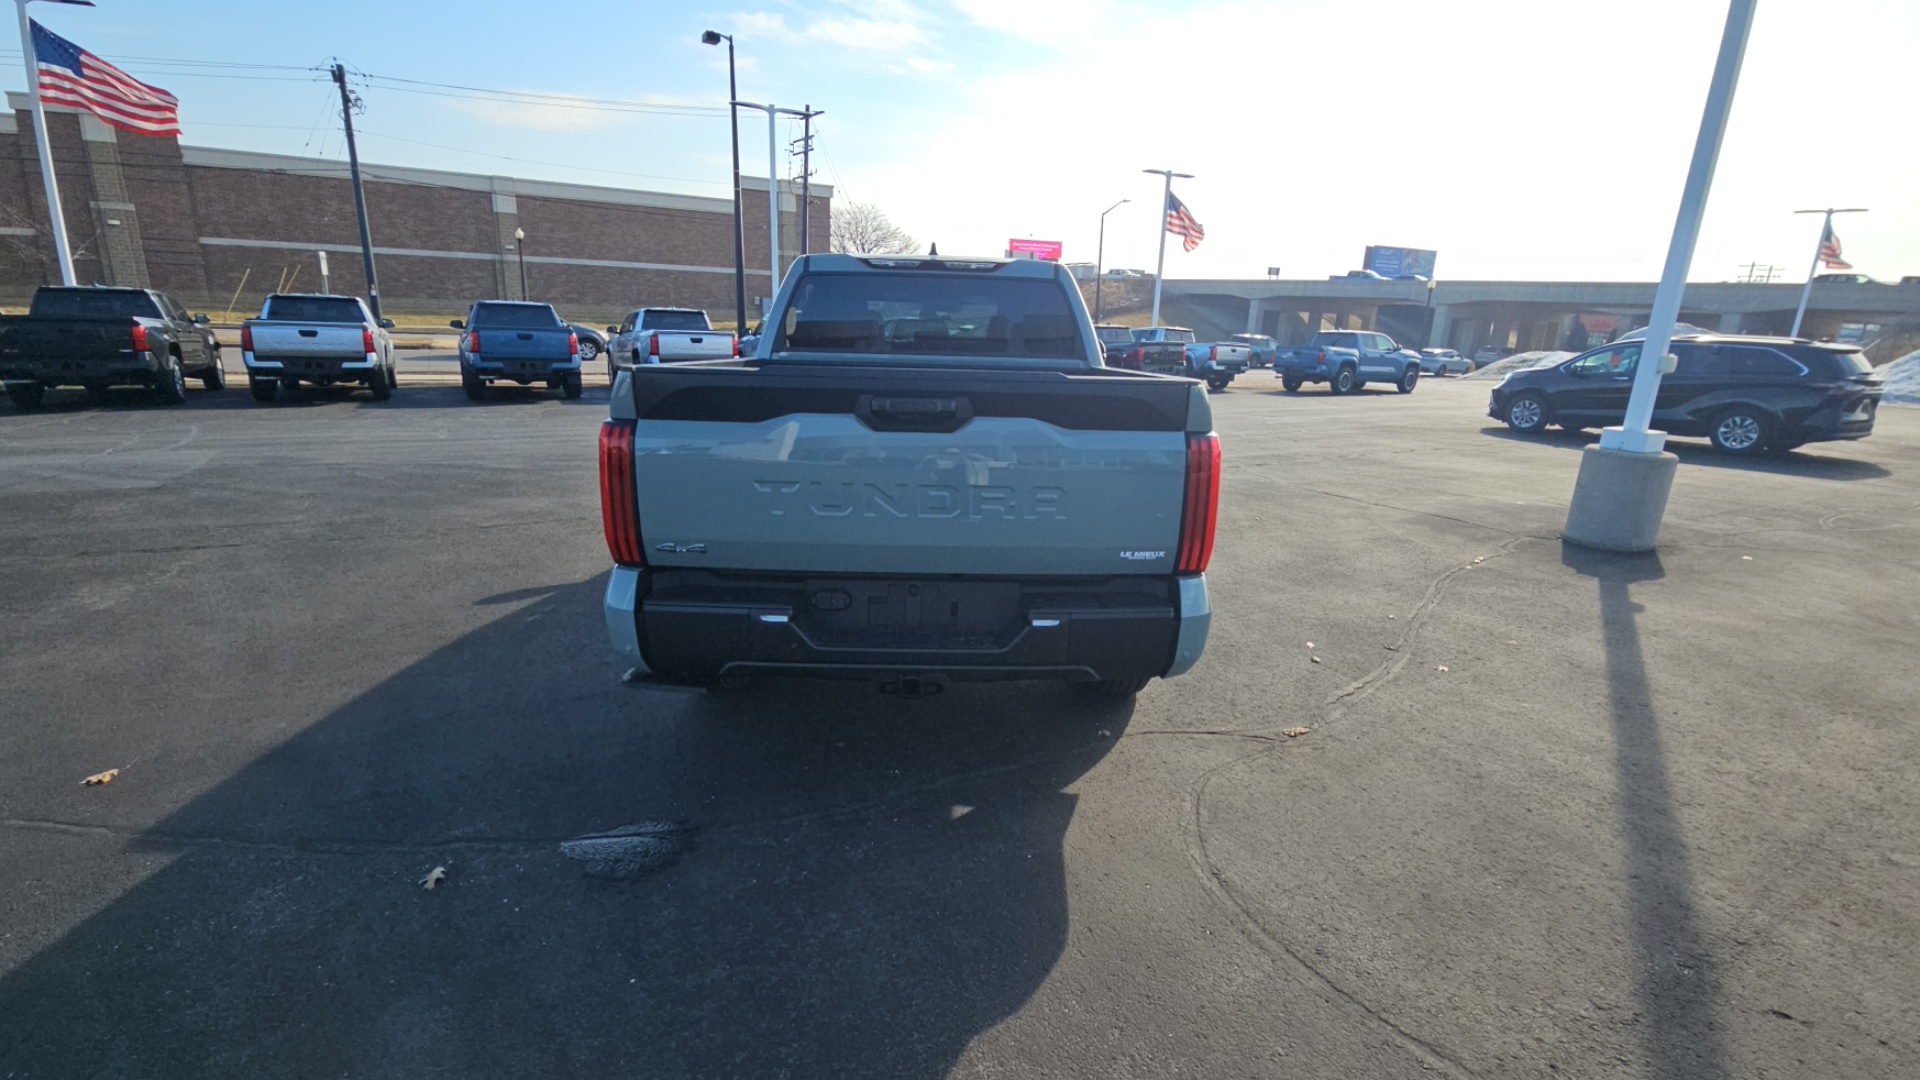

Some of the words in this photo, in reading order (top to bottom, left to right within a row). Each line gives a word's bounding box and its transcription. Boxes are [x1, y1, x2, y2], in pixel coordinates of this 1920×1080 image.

[752, 480, 1068, 520] TUNDRA
[1120, 550, 1133, 558] LE
[1134, 550, 1165, 558] MIEUX
